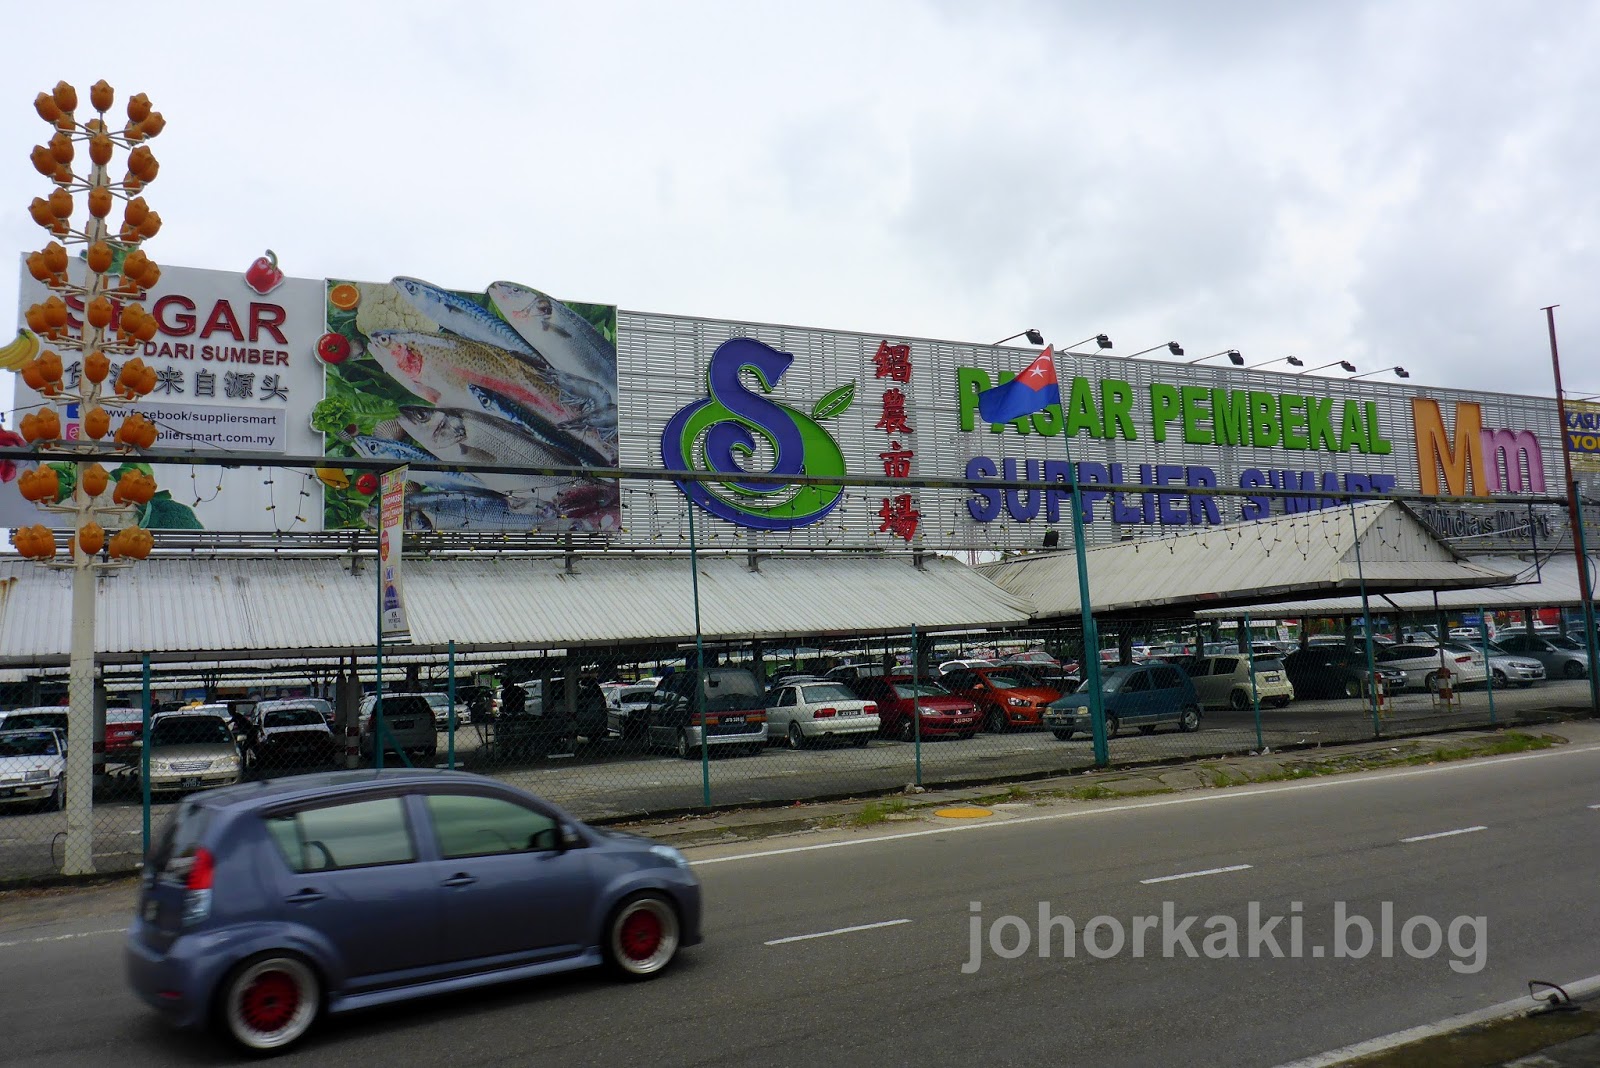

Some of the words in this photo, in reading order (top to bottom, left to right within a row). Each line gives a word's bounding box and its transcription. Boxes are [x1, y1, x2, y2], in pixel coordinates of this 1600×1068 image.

[143, 341, 195, 360] DARI
[200, 345, 290, 367] SUMBER
[1149, 383, 1392, 455] PEMBEKAL
[1569, 434, 1600, 451] YO
[965, 456, 1222, 525] SUPPLIER
[1425, 509, 1494, 537] Midas
